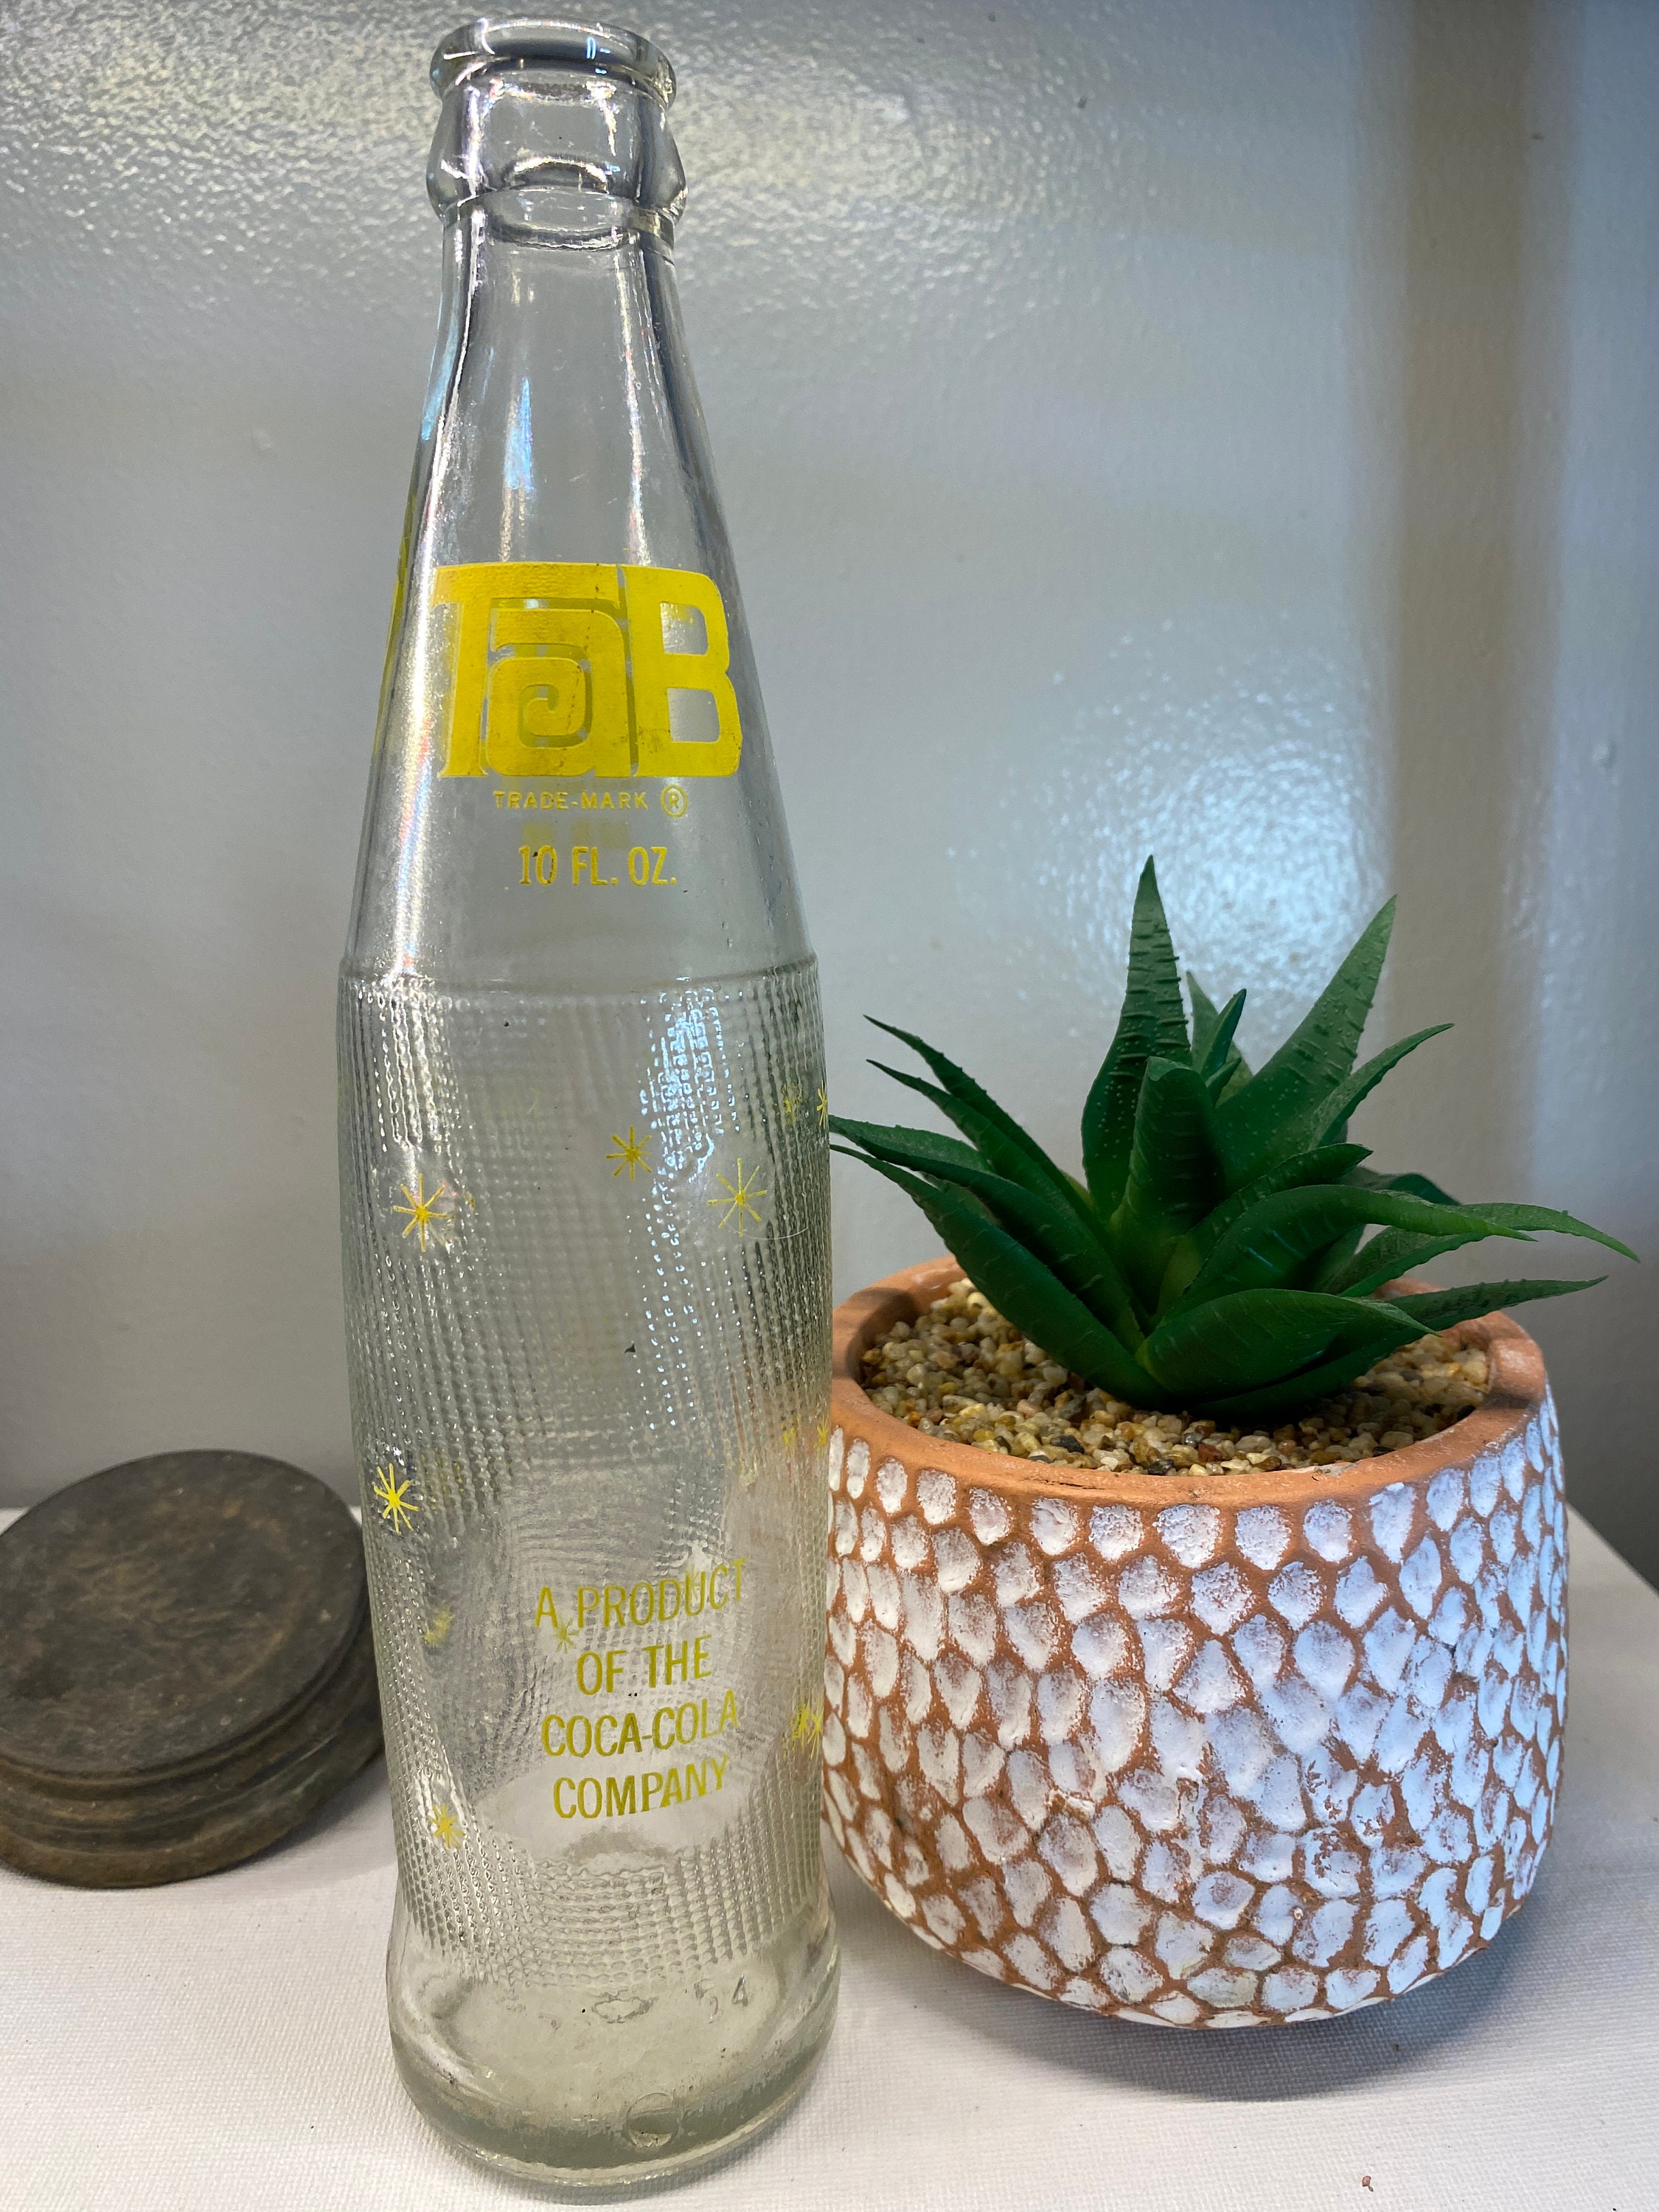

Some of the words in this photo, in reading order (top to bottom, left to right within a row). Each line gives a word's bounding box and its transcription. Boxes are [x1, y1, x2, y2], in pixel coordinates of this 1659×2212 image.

[493, 790, 648, 810] TRADE-MARK
[519, 846, 557, 885] 10
[571, 846, 618, 885] FL.
[628, 846, 678, 885] OZ.
[535, 1586, 558, 1627] A
[577, 1557, 748, 1628] PRODUCT
[576, 1650, 626, 1695] OF
[642, 1635, 712, 1688] THE
[540, 1689, 738, 1758] COCA-COLA
[553, 1753, 729, 1818] COMPANY
